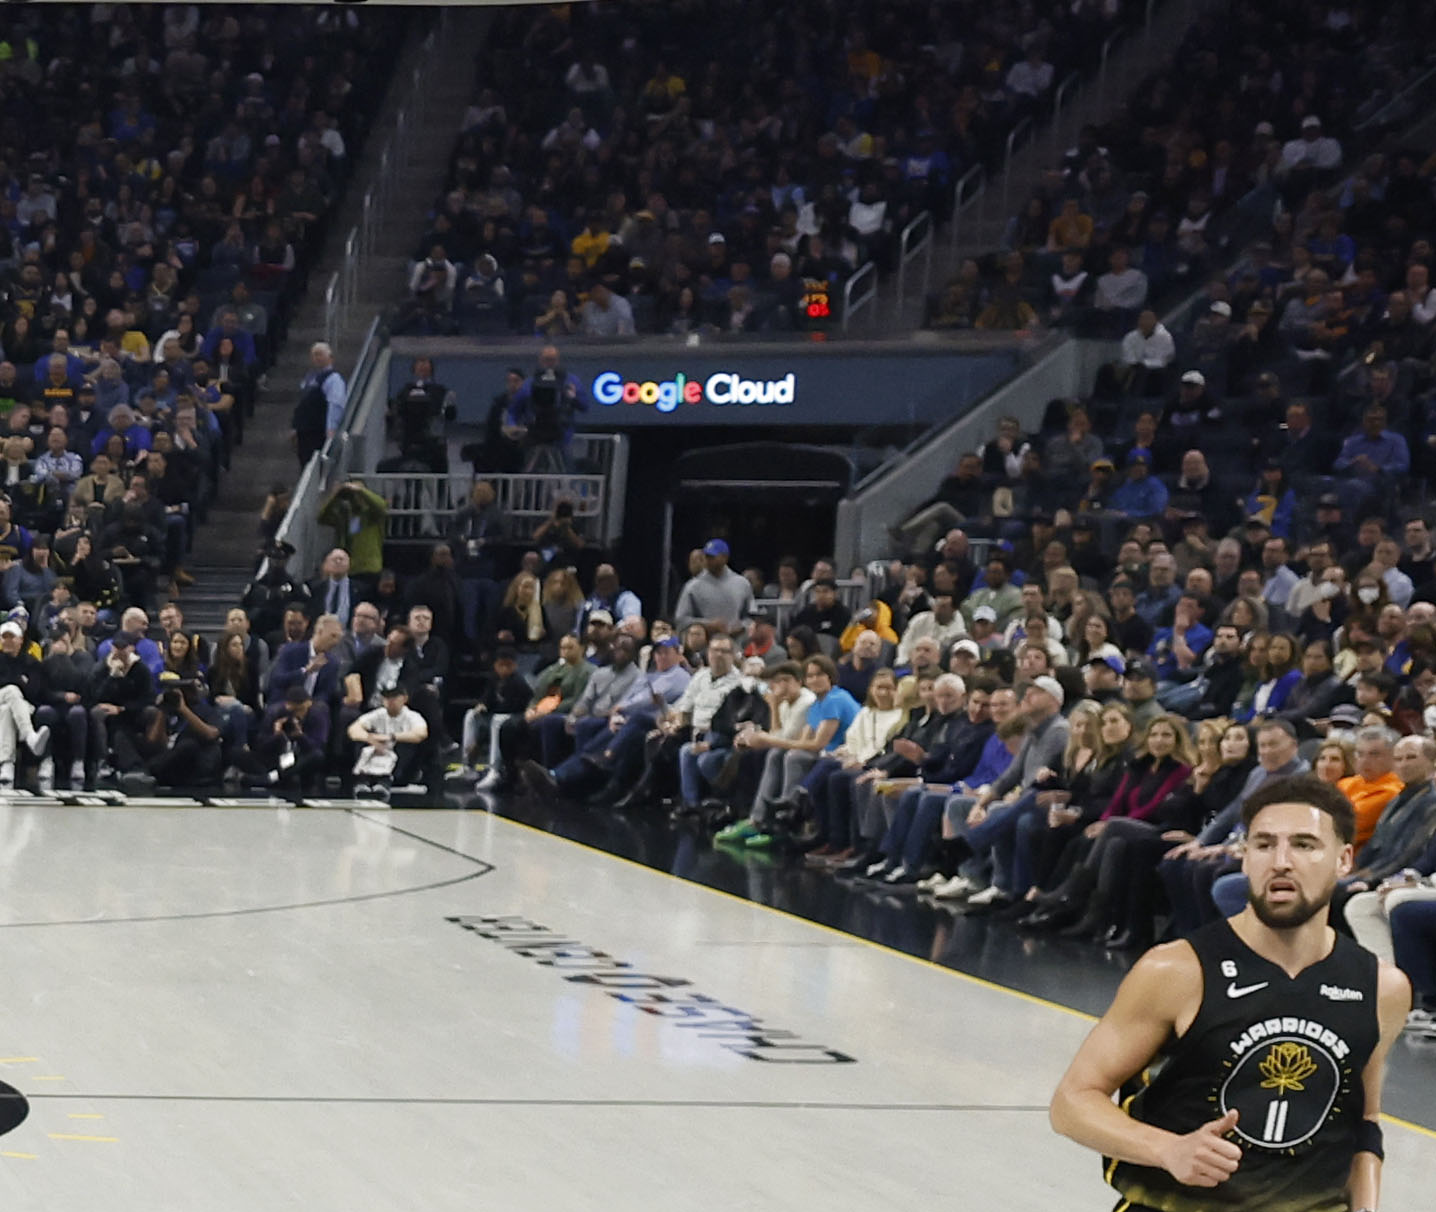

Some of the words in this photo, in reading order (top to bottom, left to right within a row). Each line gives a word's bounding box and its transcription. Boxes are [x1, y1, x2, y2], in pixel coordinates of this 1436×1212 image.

[593, 371, 702, 413] Google
[706, 372, 795, 404] Cloud
[1220, 959, 1238, 978] 6
[1319, 983, 1364, 1001] Rakuten
[1230, 1016, 1351, 1060] WARRIORS
[1263, 1099, 1289, 1143] 11
